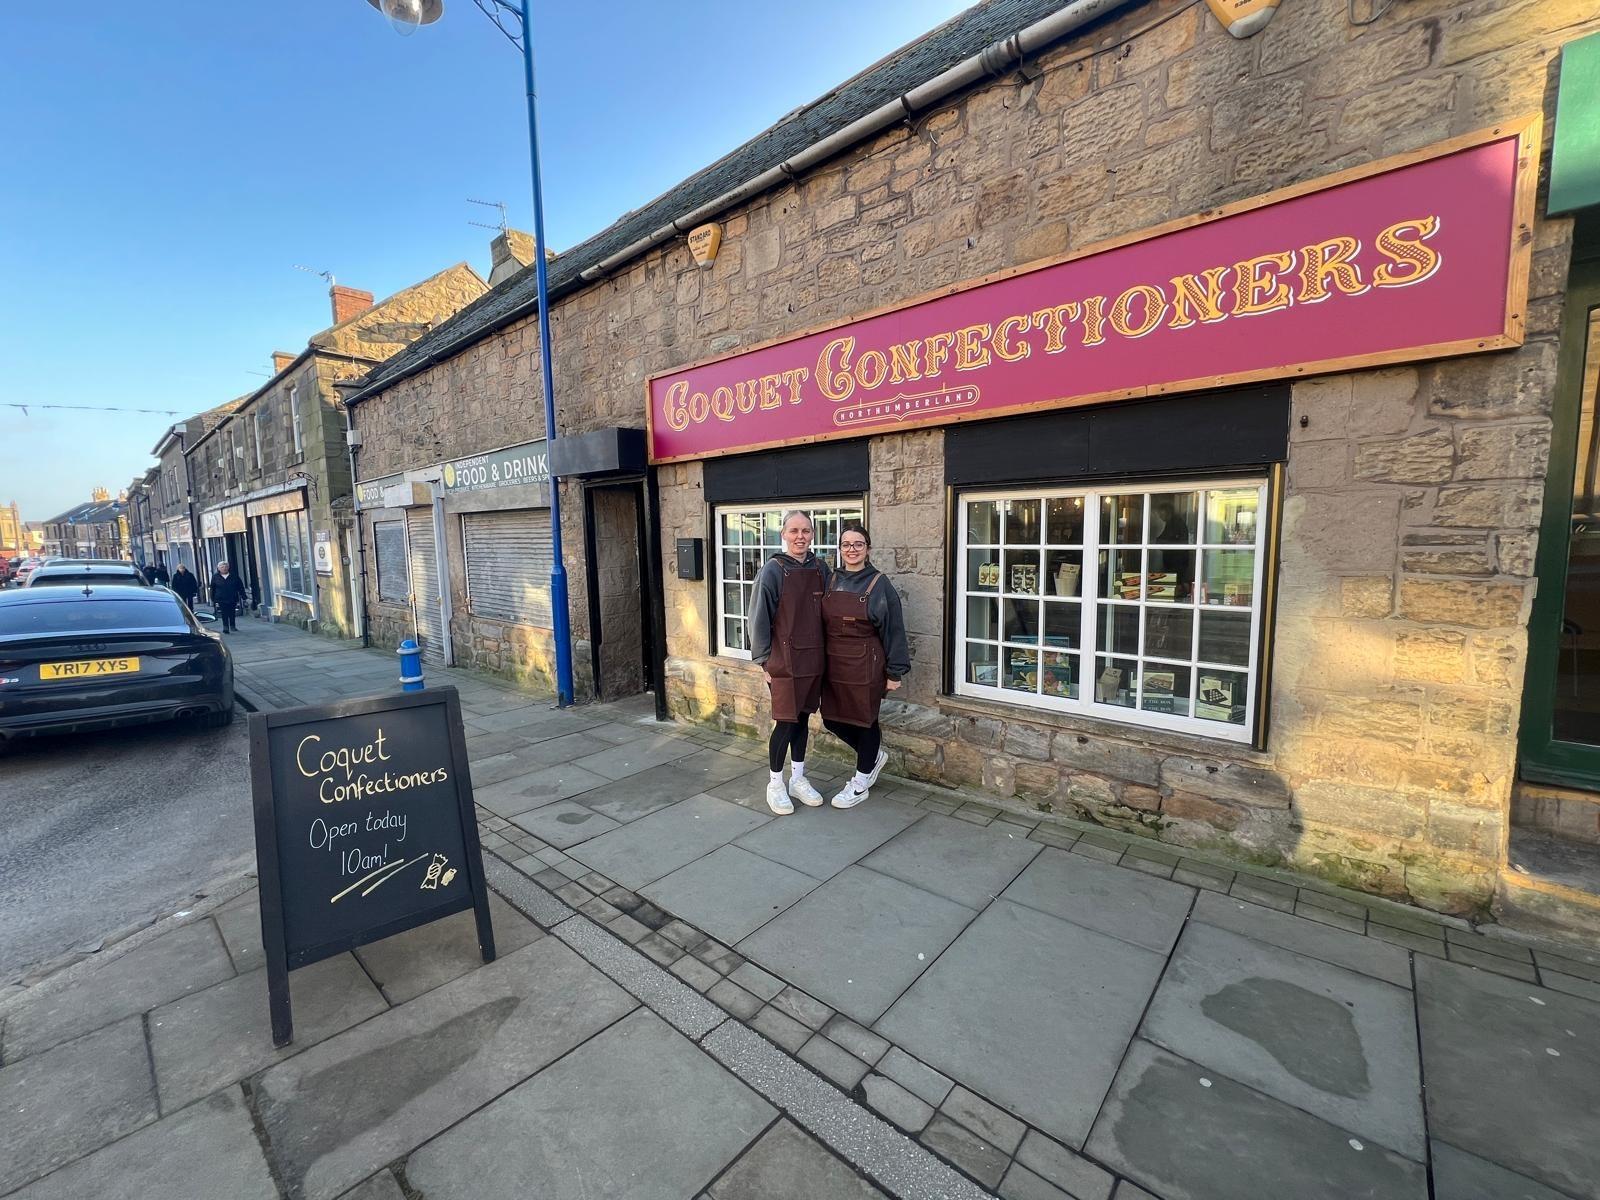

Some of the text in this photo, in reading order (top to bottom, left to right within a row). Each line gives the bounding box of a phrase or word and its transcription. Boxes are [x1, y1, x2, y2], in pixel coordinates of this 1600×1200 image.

[663, 215, 1442, 432] COQUET CONFECTIONERS
[840, 390, 974, 421] NORTHUMBERLAND
[455, 456, 489, 469] INDEPENDENT
[456, 453, 549, 487] FOOD & DRINK
[363, 487, 379, 500] FOOD
[498, 478, 521, 487] GROCERIES
[52, 659, 129, 676] YR17 XYS
[296, 728, 392, 780] Coquet
[319, 767, 448, 804] Confectioners
[309, 810, 407, 851] Open today
[341, 843, 388, 875] 10am!
